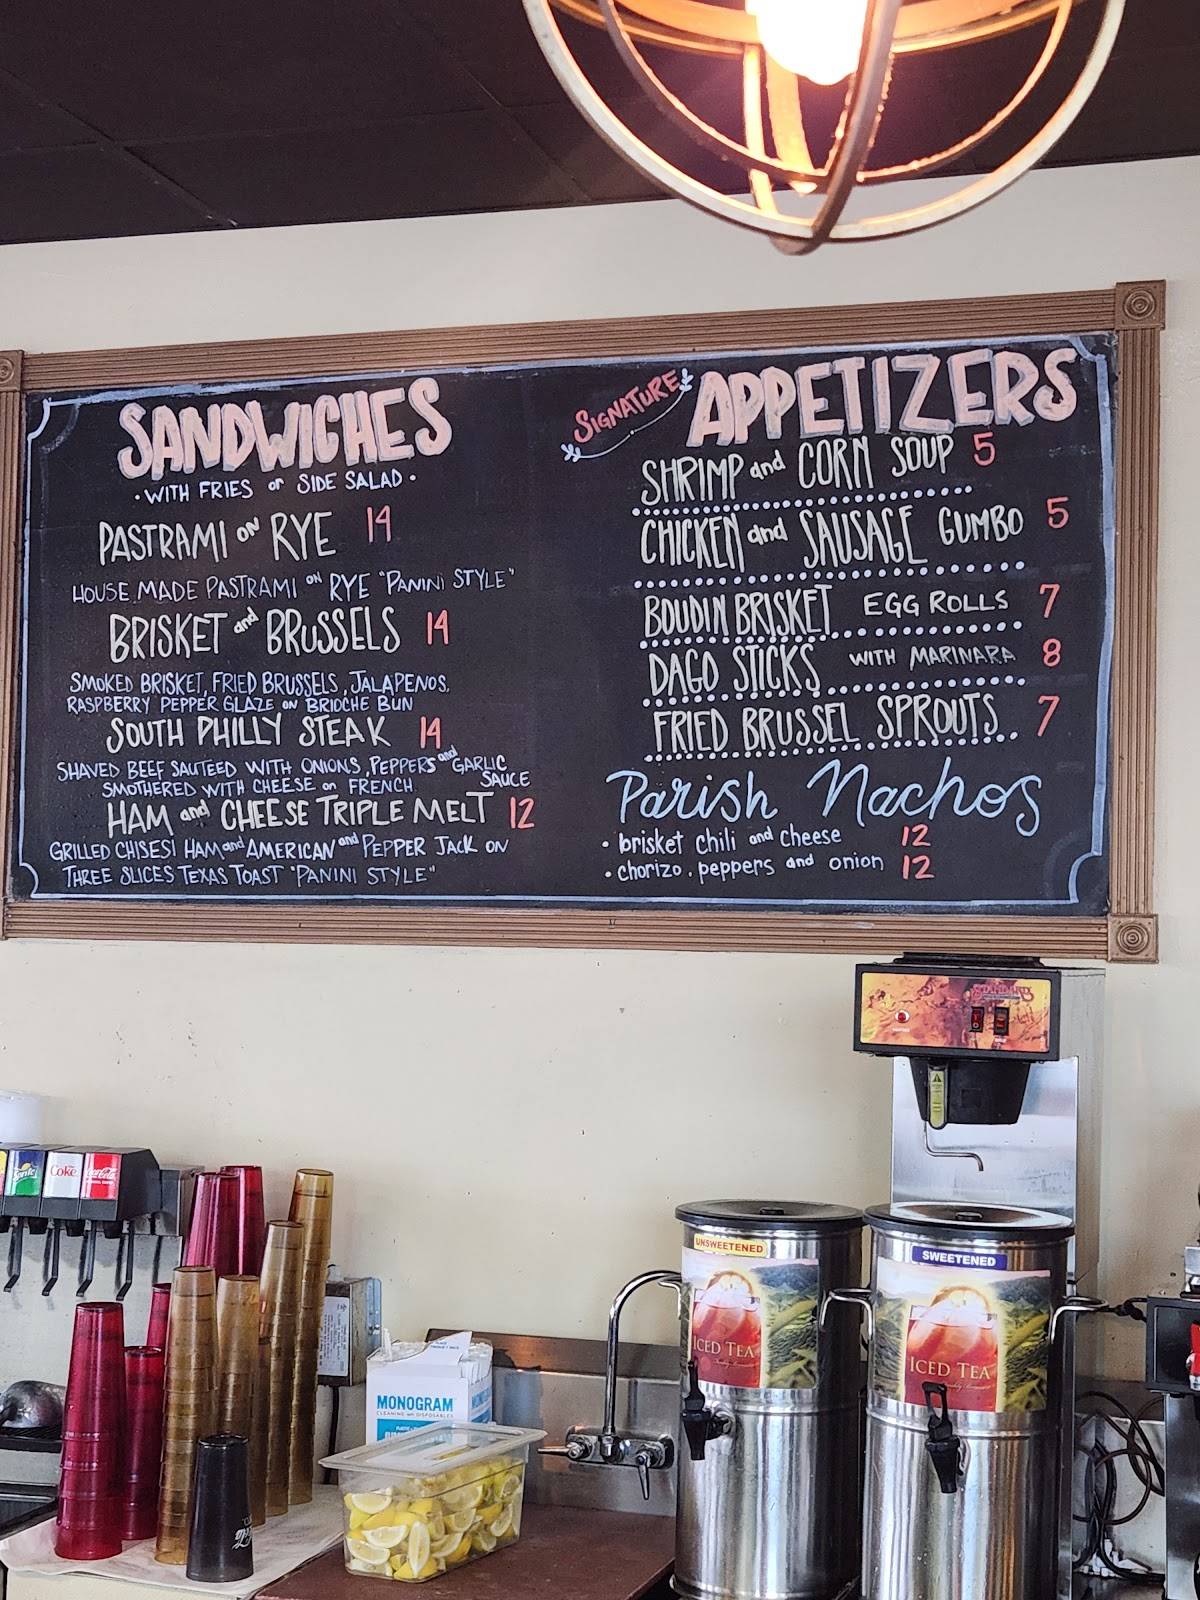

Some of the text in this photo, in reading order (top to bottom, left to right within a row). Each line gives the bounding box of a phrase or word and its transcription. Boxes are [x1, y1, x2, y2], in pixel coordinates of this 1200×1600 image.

[573, 369, 681, 443] SIGNATURE
[686, 348, 1077, 447] APPETIZERS
[118, 377, 452, 480] SANDWICHES
[641, 432, 996, 505] SHRIMP and CORN SOUP 5
[144, 469, 402, 504] WITH FRIES or SIDE SALAD
[100, 505, 392, 566] PASTRAMI ON RYE 14
[641, 496, 1069, 573] CHICKEN and SAUSAGE GUMBO 5
[72, 582, 129, 604] HOUSE
[137, 580, 198, 602] MADE
[206, 574, 297, 600] PASTRAMI
[306, 571, 323, 585] ON
[329, 573, 371, 602] RYE
[644, 583, 1060, 638] BOUDIN BRISKET EGG ROLLS 7
[110, 612, 228, 663] BRISKET
[233, 606, 260, 634] and
[426, 609, 449, 645] 14
[69, 672, 133, 693] SMOKED
[140, 671, 208, 697] BRISKET,
[212, 671, 257, 695] FRIED
[649, 638, 1062, 696] DAGO STICKS WITH MARINARA 8
[67, 695, 413, 714] RASPBERRY PEPPER GLAZE ON BRIOCHE BUN
[106, 712, 441, 754] SOUTH PHILLY STEAK 14
[653, 692, 1060, 754] FRIED BRUSSEL SPROUTS 7
[57, 761, 120, 781] SHAVED
[127, 760, 165, 780] BEEF
[171, 758, 237, 778] SAUTEED
[245, 758, 292, 776] WITH
[369, 755, 436, 775] PEPPERS
[437, 745, 458, 762] and
[452, 755, 508, 775] GARLIC
[480, 771, 530, 788] SAUCE
[102, 780, 197, 798] SMOTHERED
[202, 779, 245, 798] WITH
[253, 777, 316, 794] CHEESE
[349, 777, 413, 796] FRENCH
[605, 756, 1042, 837] Parish Nachos
[107, 791, 535, 838] HAM and CHEESE TRIPLE MELT 12
[49, 832, 509, 862] GRILLED CHISESI HAM and AMERICAN and PEPPER JACK ON
[619, 823, 931, 855] brisket chili and cheese 12
[62, 865, 113, 888] THREE
[120, 865, 175, 886] SLICES
[177, 865, 229, 886] TEXAS
[229, 864, 284, 886] TOAST
[698, 857, 775, 884] peppers
[785, 853, 814, 869] and
[828, 852, 884, 871] onion
[902, 854, 934, 880] 12
[50, 1164, 78, 1177] Coke
[695, 1237, 764, 1254] UNSWEETENED
[922, 1250, 996, 1267] SWEETENED
[693, 1334, 755, 1358] ICED TEA
[910, 1356, 991, 1380] ICED TEA
[377, 1395, 453, 1412] MONOGRAM
